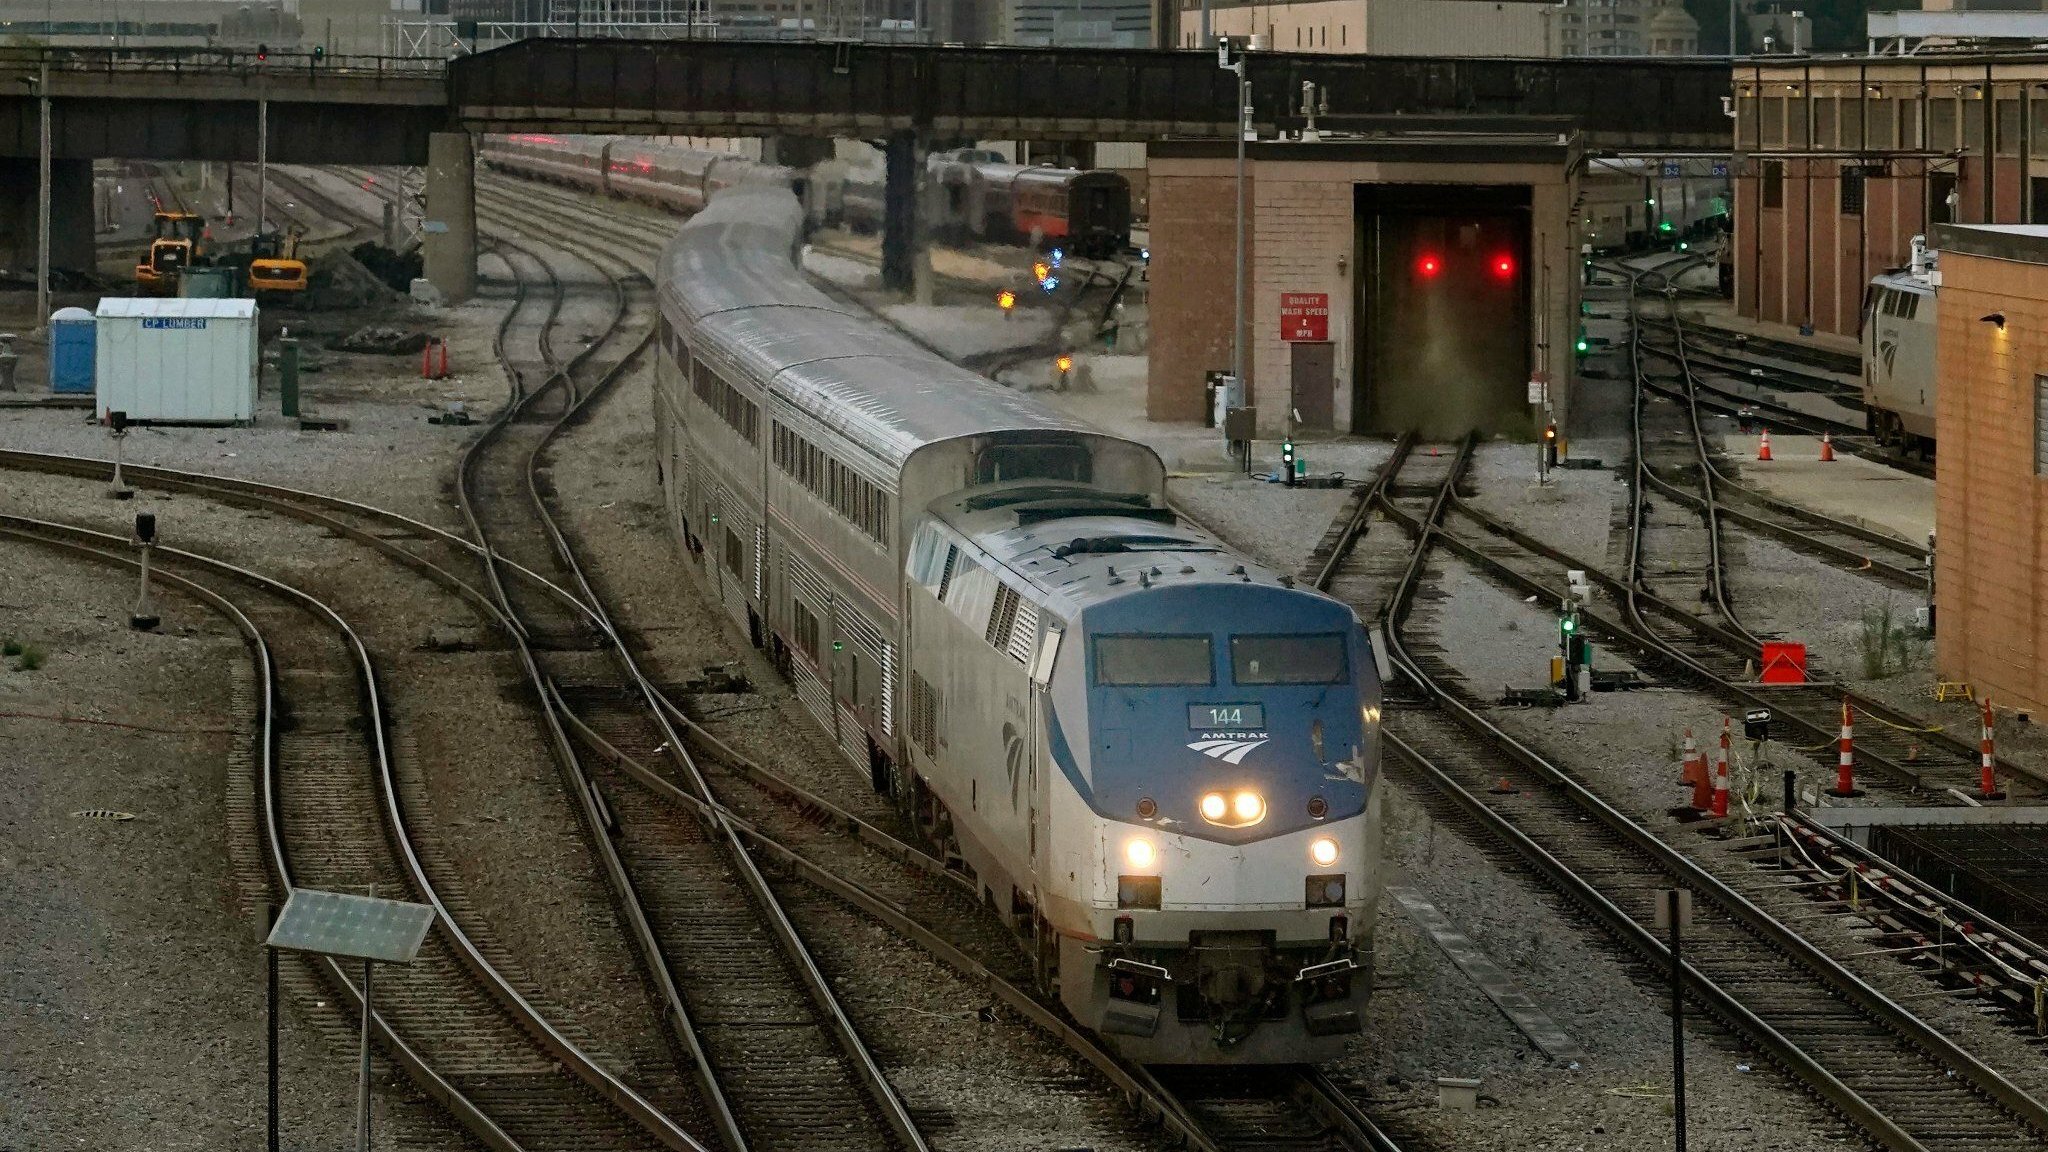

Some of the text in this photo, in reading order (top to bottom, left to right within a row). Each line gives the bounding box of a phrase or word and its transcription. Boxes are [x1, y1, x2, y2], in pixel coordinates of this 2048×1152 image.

[1665, 167, 1679, 176] D-2
[1289, 297, 1320, 305] QUALITY
[1306, 307, 1328, 316] SPEED
[145, 319, 204, 329] CP LUMBER
[1302, 318, 1308, 327] 2
[1296, 330, 1313, 338] MPH
[1209, 708, 1242, 725] 144
